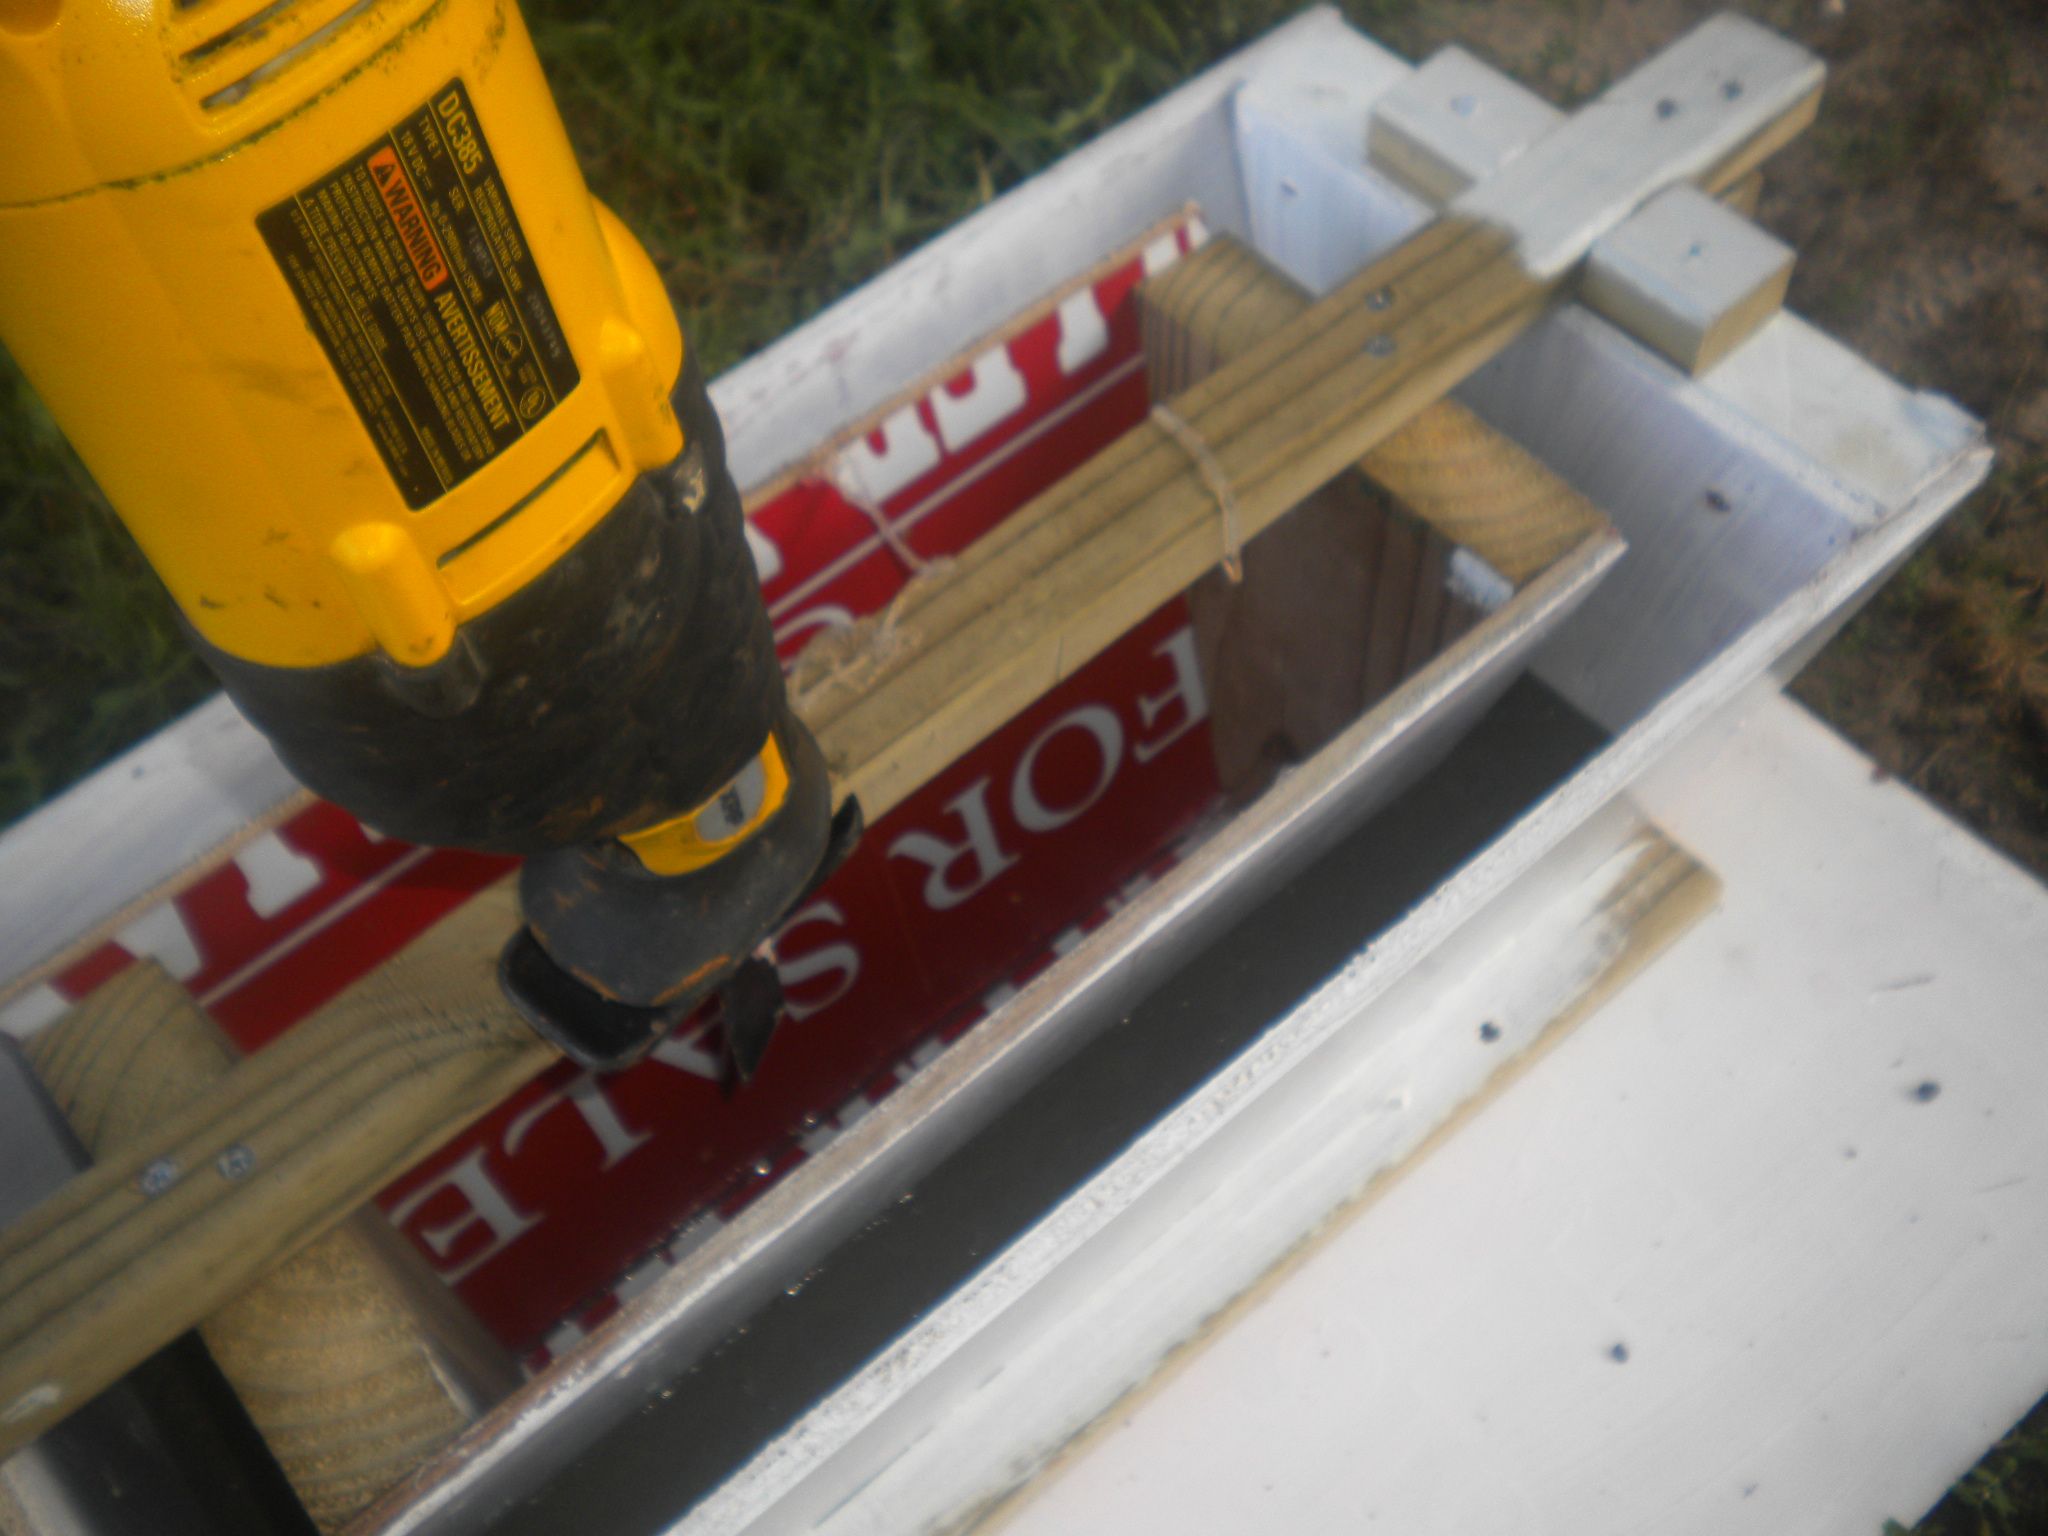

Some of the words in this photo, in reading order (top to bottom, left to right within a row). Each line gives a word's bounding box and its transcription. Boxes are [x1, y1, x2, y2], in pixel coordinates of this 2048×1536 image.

[416, 115, 439, 151] TYPE
[435, 89, 486, 177] DC385
[360, 179, 384, 220] REDUCE
[383, 178, 442, 283] WARNING
[340, 172, 379, 242] INSTRUCTION
[393, 282, 419, 324] ALWAYS
[359, 244, 385, 287] REMOVE
[379, 284, 405, 328] BATTERY
[432, 287, 510, 434] AVERTISSEMENT
[885, 623, 1212, 914] FOR
